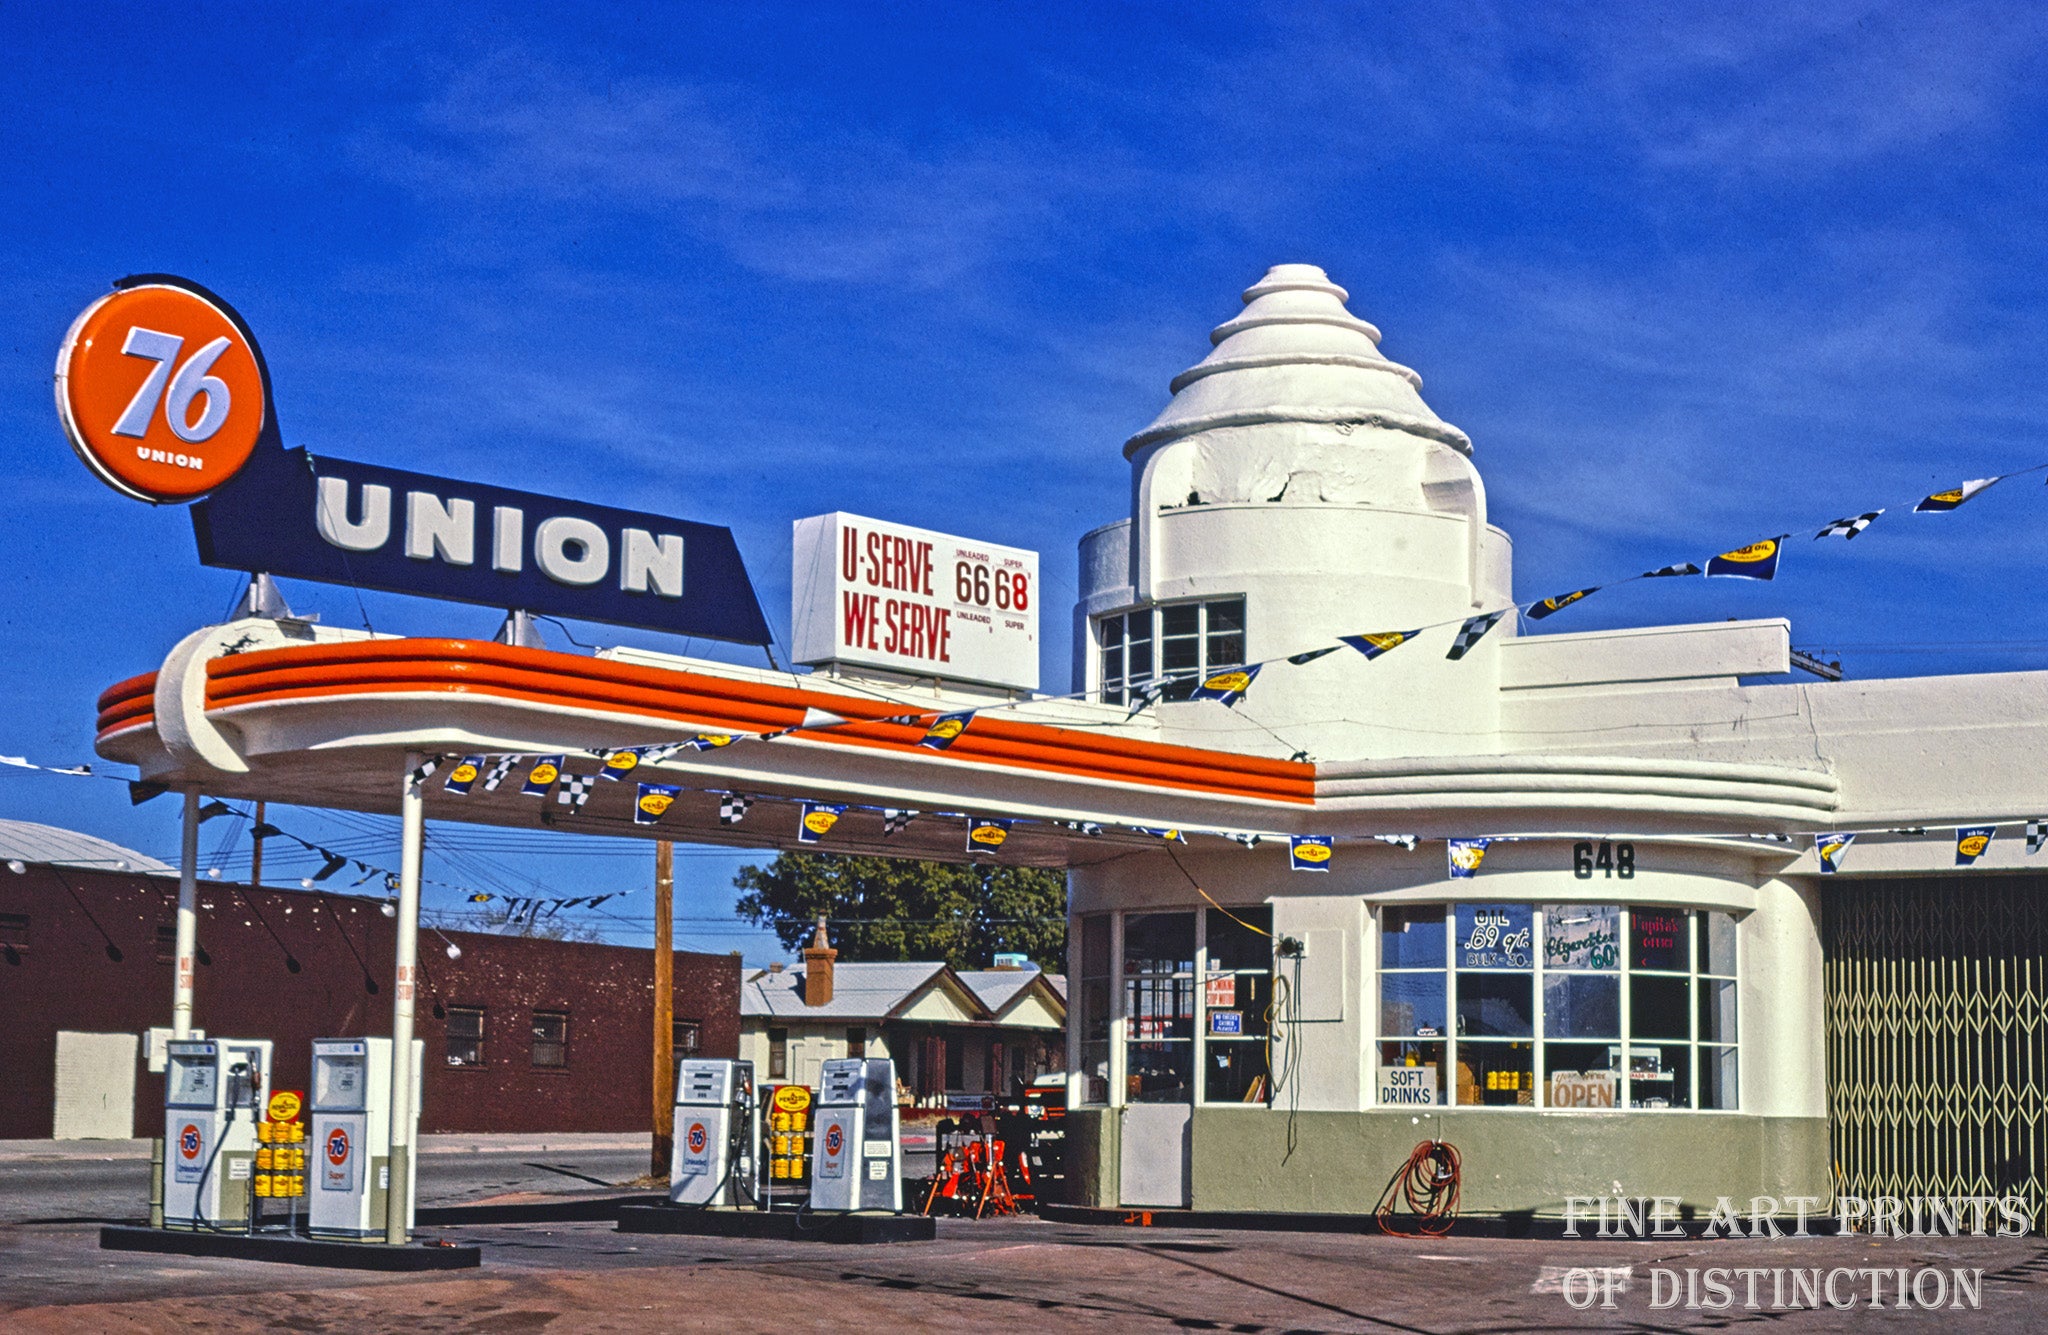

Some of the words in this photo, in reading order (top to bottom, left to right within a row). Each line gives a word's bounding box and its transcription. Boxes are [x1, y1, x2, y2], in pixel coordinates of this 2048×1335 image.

[111, 326, 232, 444] 76
[137, 446, 203, 470] UNION
[316, 476, 684, 598] UNION
[956, 548, 990, 562] UNLEADED
[1004, 558, 1023, 569] SUPER
[956, 560, 990, 607] 66
[995, 569, 1029, 611] 68
[842, 590, 880, 652] WE
[884, 598, 952, 664] SERVE
[956, 611, 991, 624] UNLEADED
[1005, 620, 1025, 631] SUPER
[1573, 842, 1635, 880] 648
[1475, 909, 1510, 926] OIL
[1547, 929, 1615, 962] Cigarettes
[1467, 952, 1498, 967] BULK
[1390, 1070, 1424, 1086] SOFT
[1383, 1087, 1431, 1104] DRINKS
[1554, 1083, 1613, 1108] OPEN
[183, 1130, 199, 1152] 76
[329, 1135, 346, 1158] 76
[690, 1129, 705, 1147] 76
[828, 1130, 841, 1149] 76
